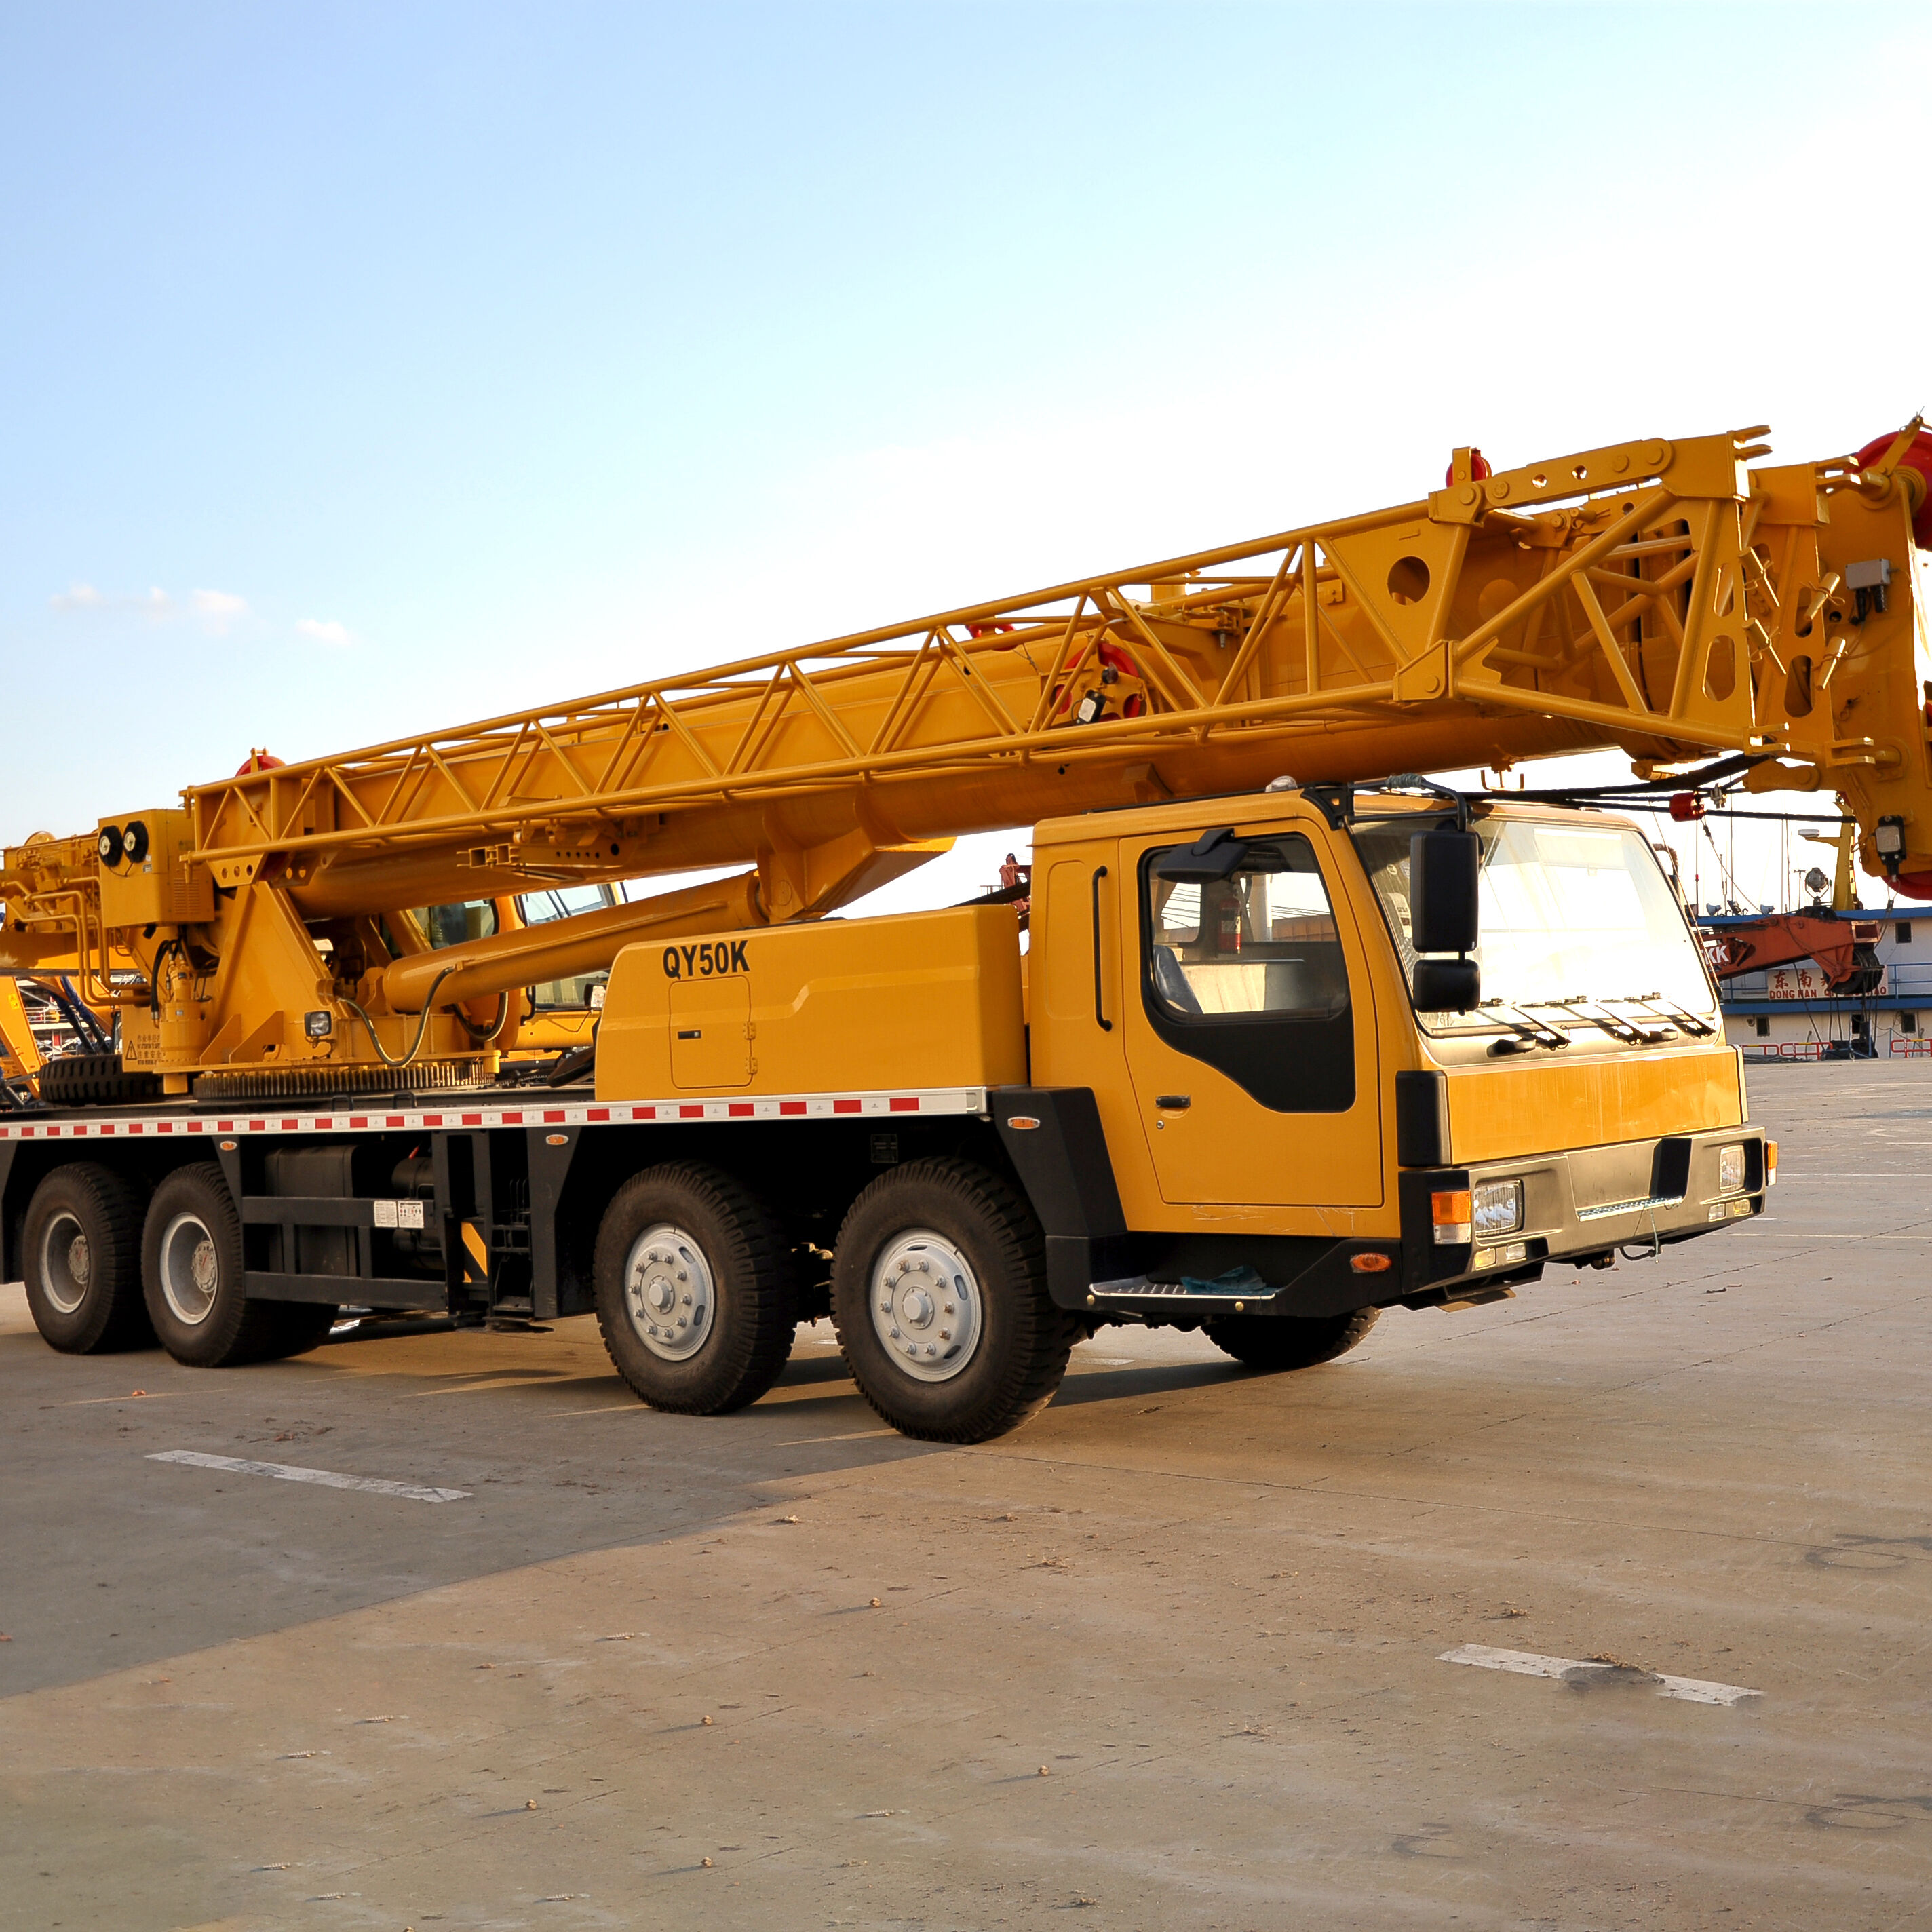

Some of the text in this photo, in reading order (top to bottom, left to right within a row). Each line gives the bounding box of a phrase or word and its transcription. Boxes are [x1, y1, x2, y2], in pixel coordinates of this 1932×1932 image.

[663, 940, 750, 980] QY50K
[1769, 990, 1795, 999] DONG
[1798, 989, 1817, 998] NAN
